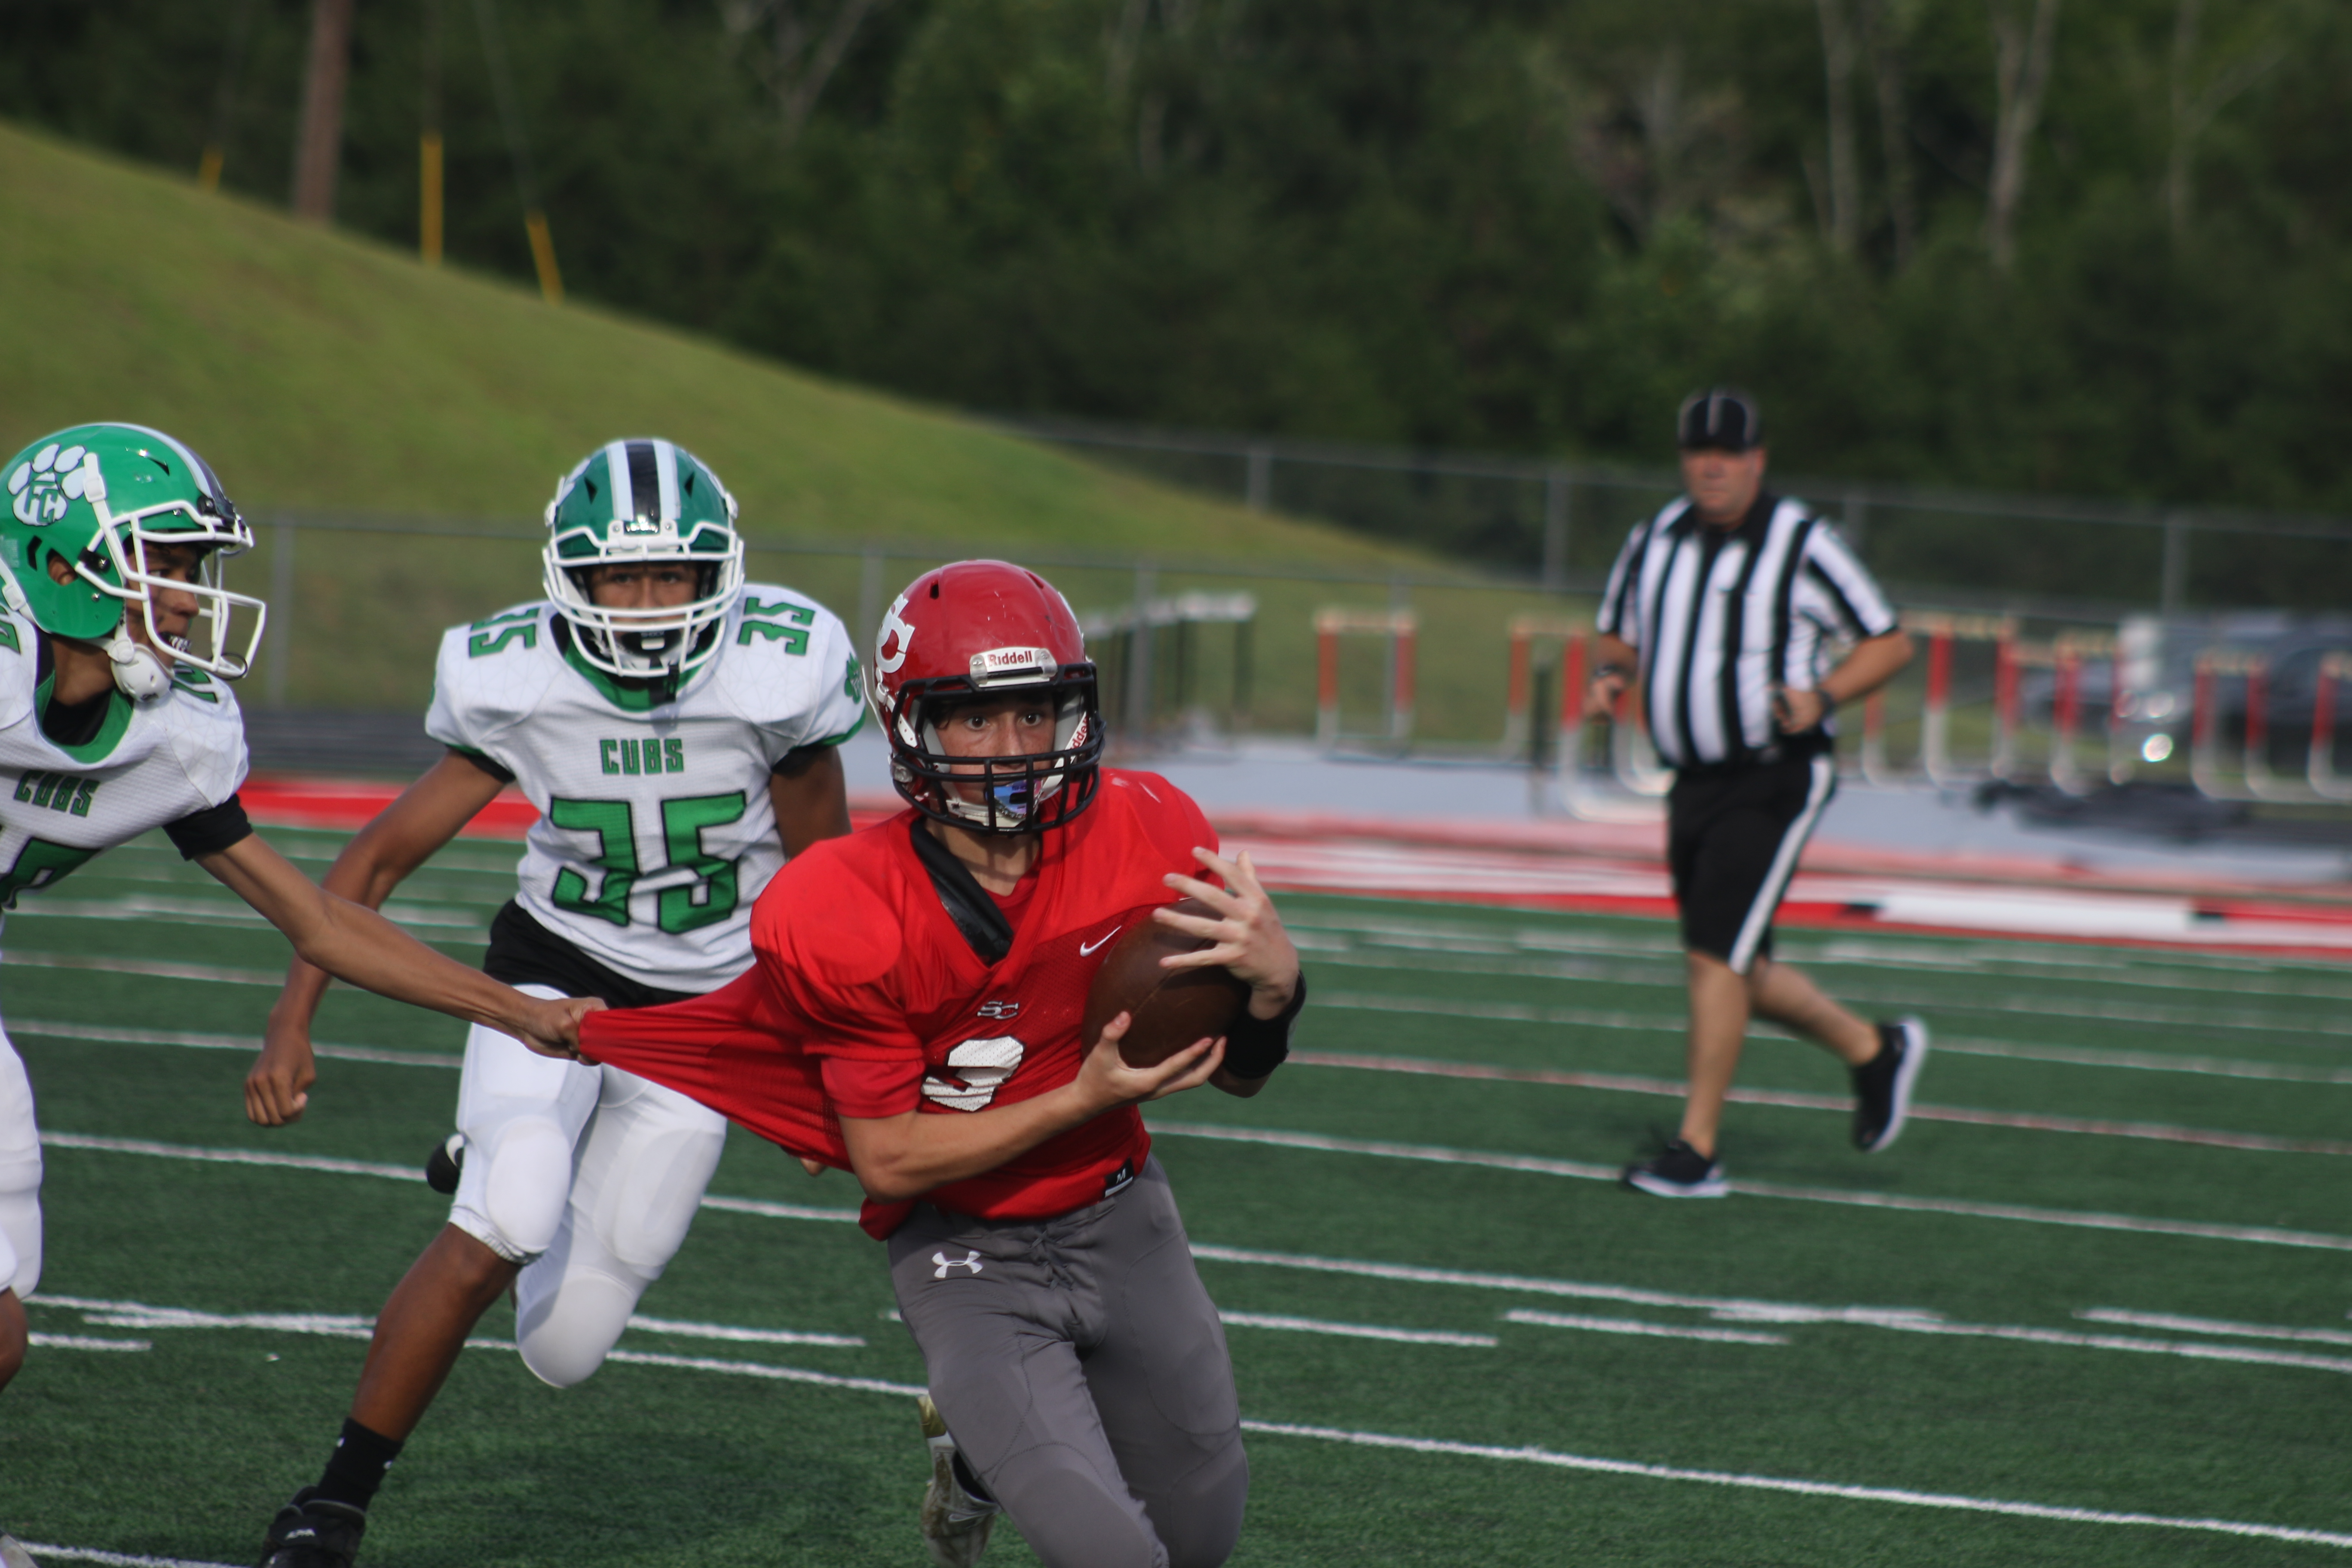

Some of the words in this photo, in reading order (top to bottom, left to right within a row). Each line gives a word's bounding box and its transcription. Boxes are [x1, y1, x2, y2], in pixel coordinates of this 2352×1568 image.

[737, 597, 815, 656] 35
[988, 650, 1032, 666] Riddell
[600, 738, 683, 775] CUBS
[13, 769, 100, 818] CUBS
[550, 789, 746, 934] 35
[977, 1001, 1018, 1020] SC
